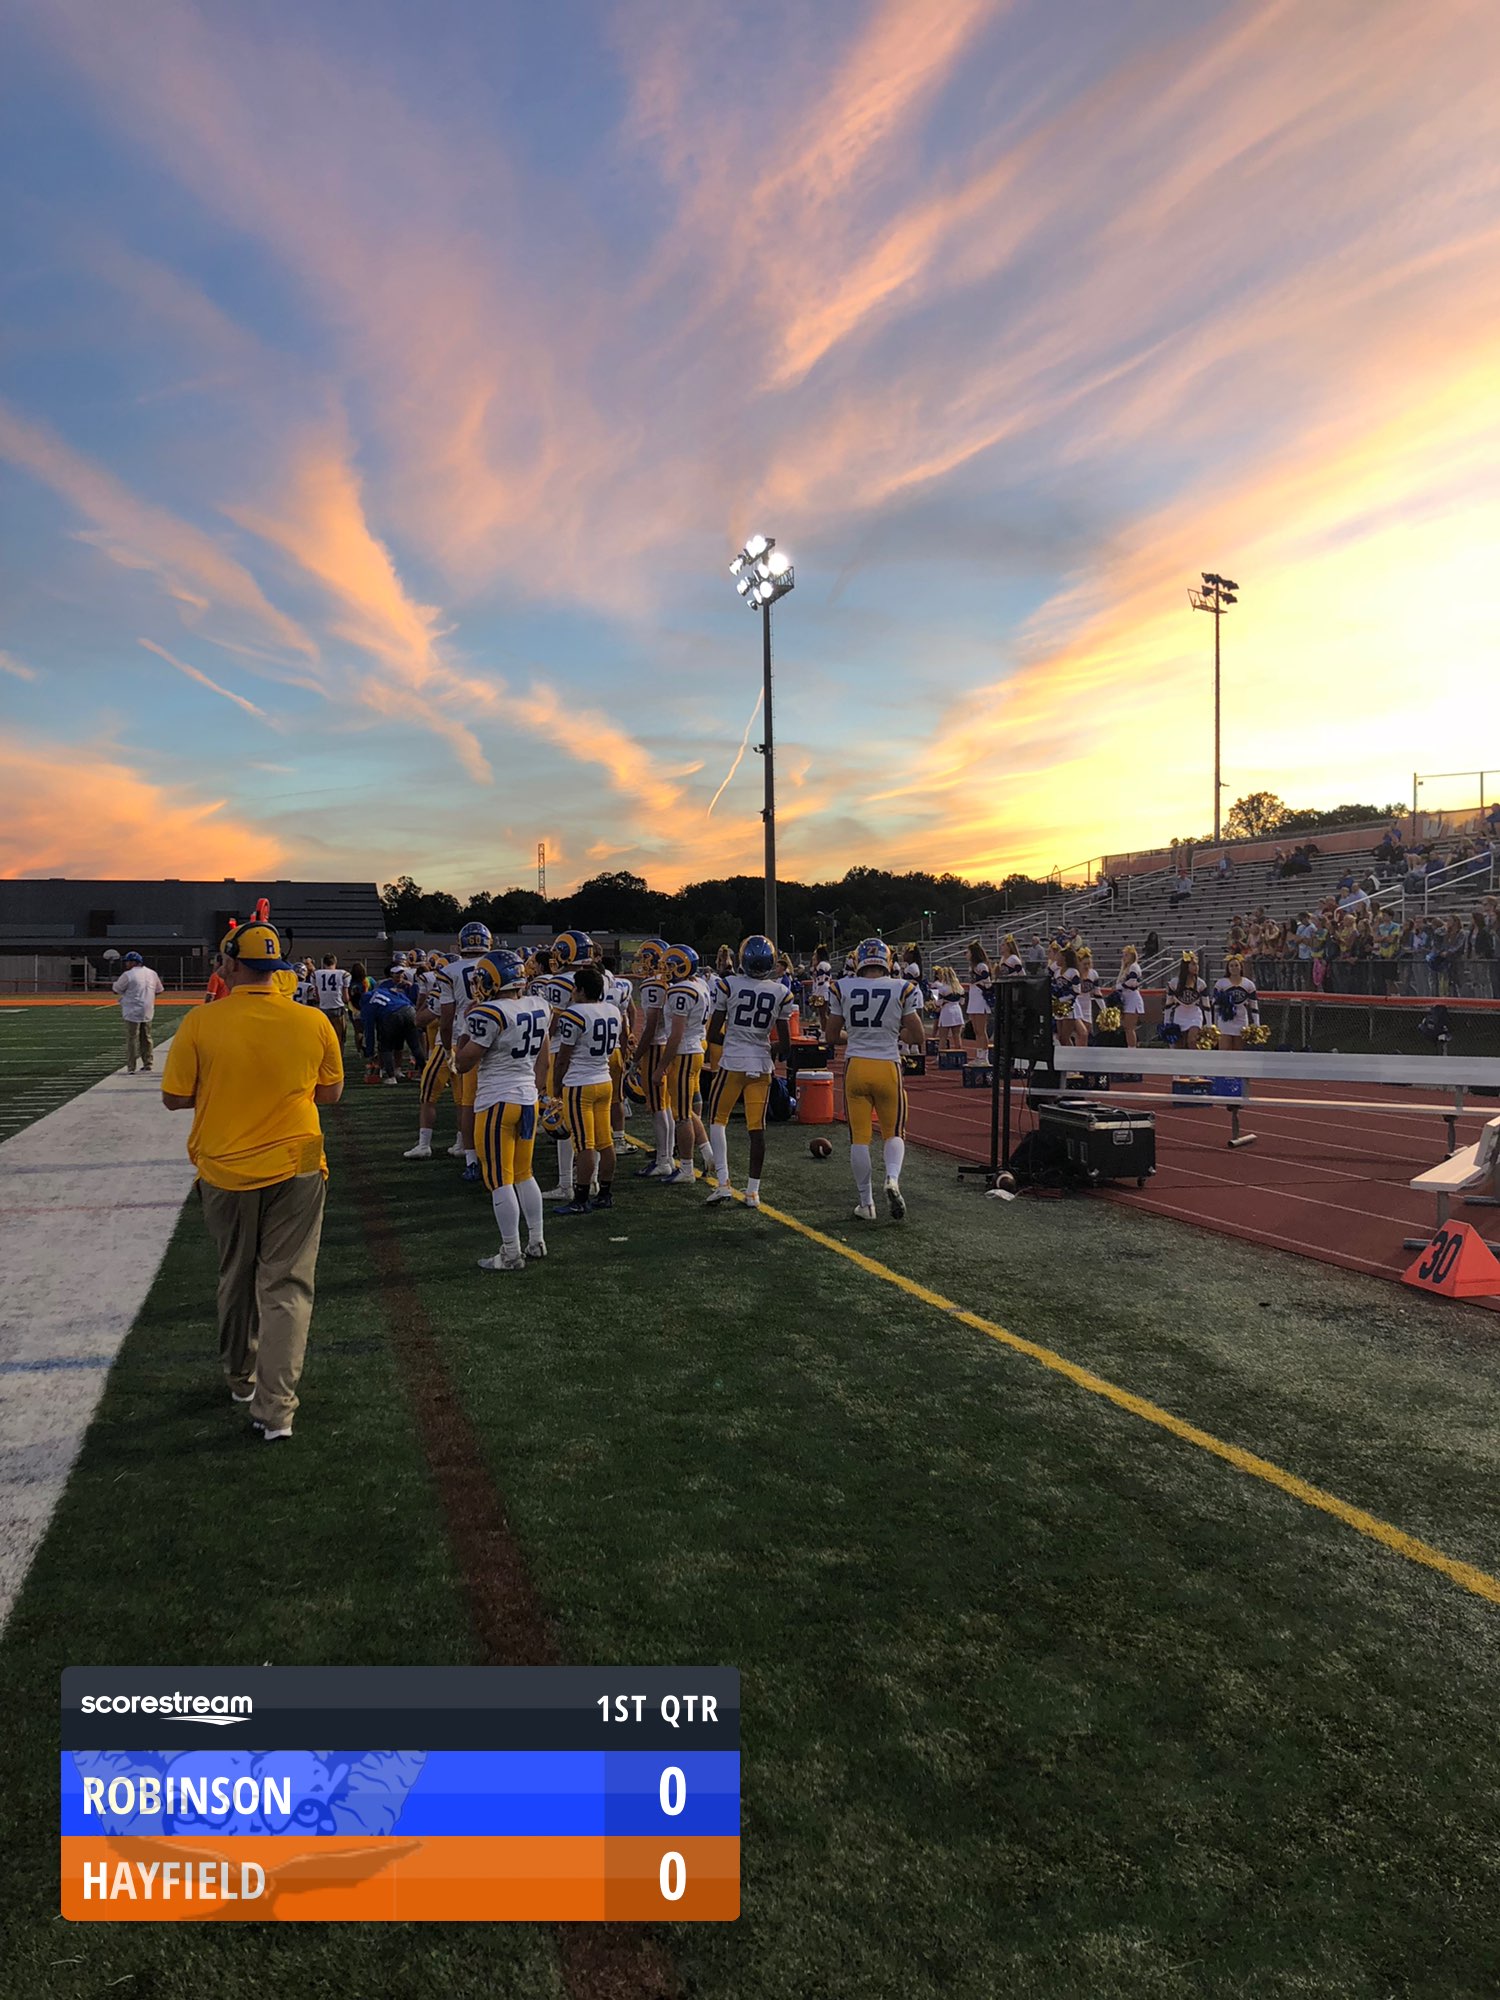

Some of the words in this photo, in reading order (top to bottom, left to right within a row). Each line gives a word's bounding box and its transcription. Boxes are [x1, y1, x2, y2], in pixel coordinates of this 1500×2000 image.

[264, 939, 276, 954] R
[468, 934, 482, 945] 60
[321, 974, 338, 992] 14
[548, 986, 562, 1003] 18
[648, 989, 658, 1003] 5
[676, 996, 686, 1011] 8
[734, 989, 777, 1029] 28
[850, 988, 892, 1028] 27
[468, 1017, 488, 1037] 35
[511, 1009, 547, 1060] 35
[589, 1017, 619, 1057] 96
[1418, 1230, 1464, 1285] 30
